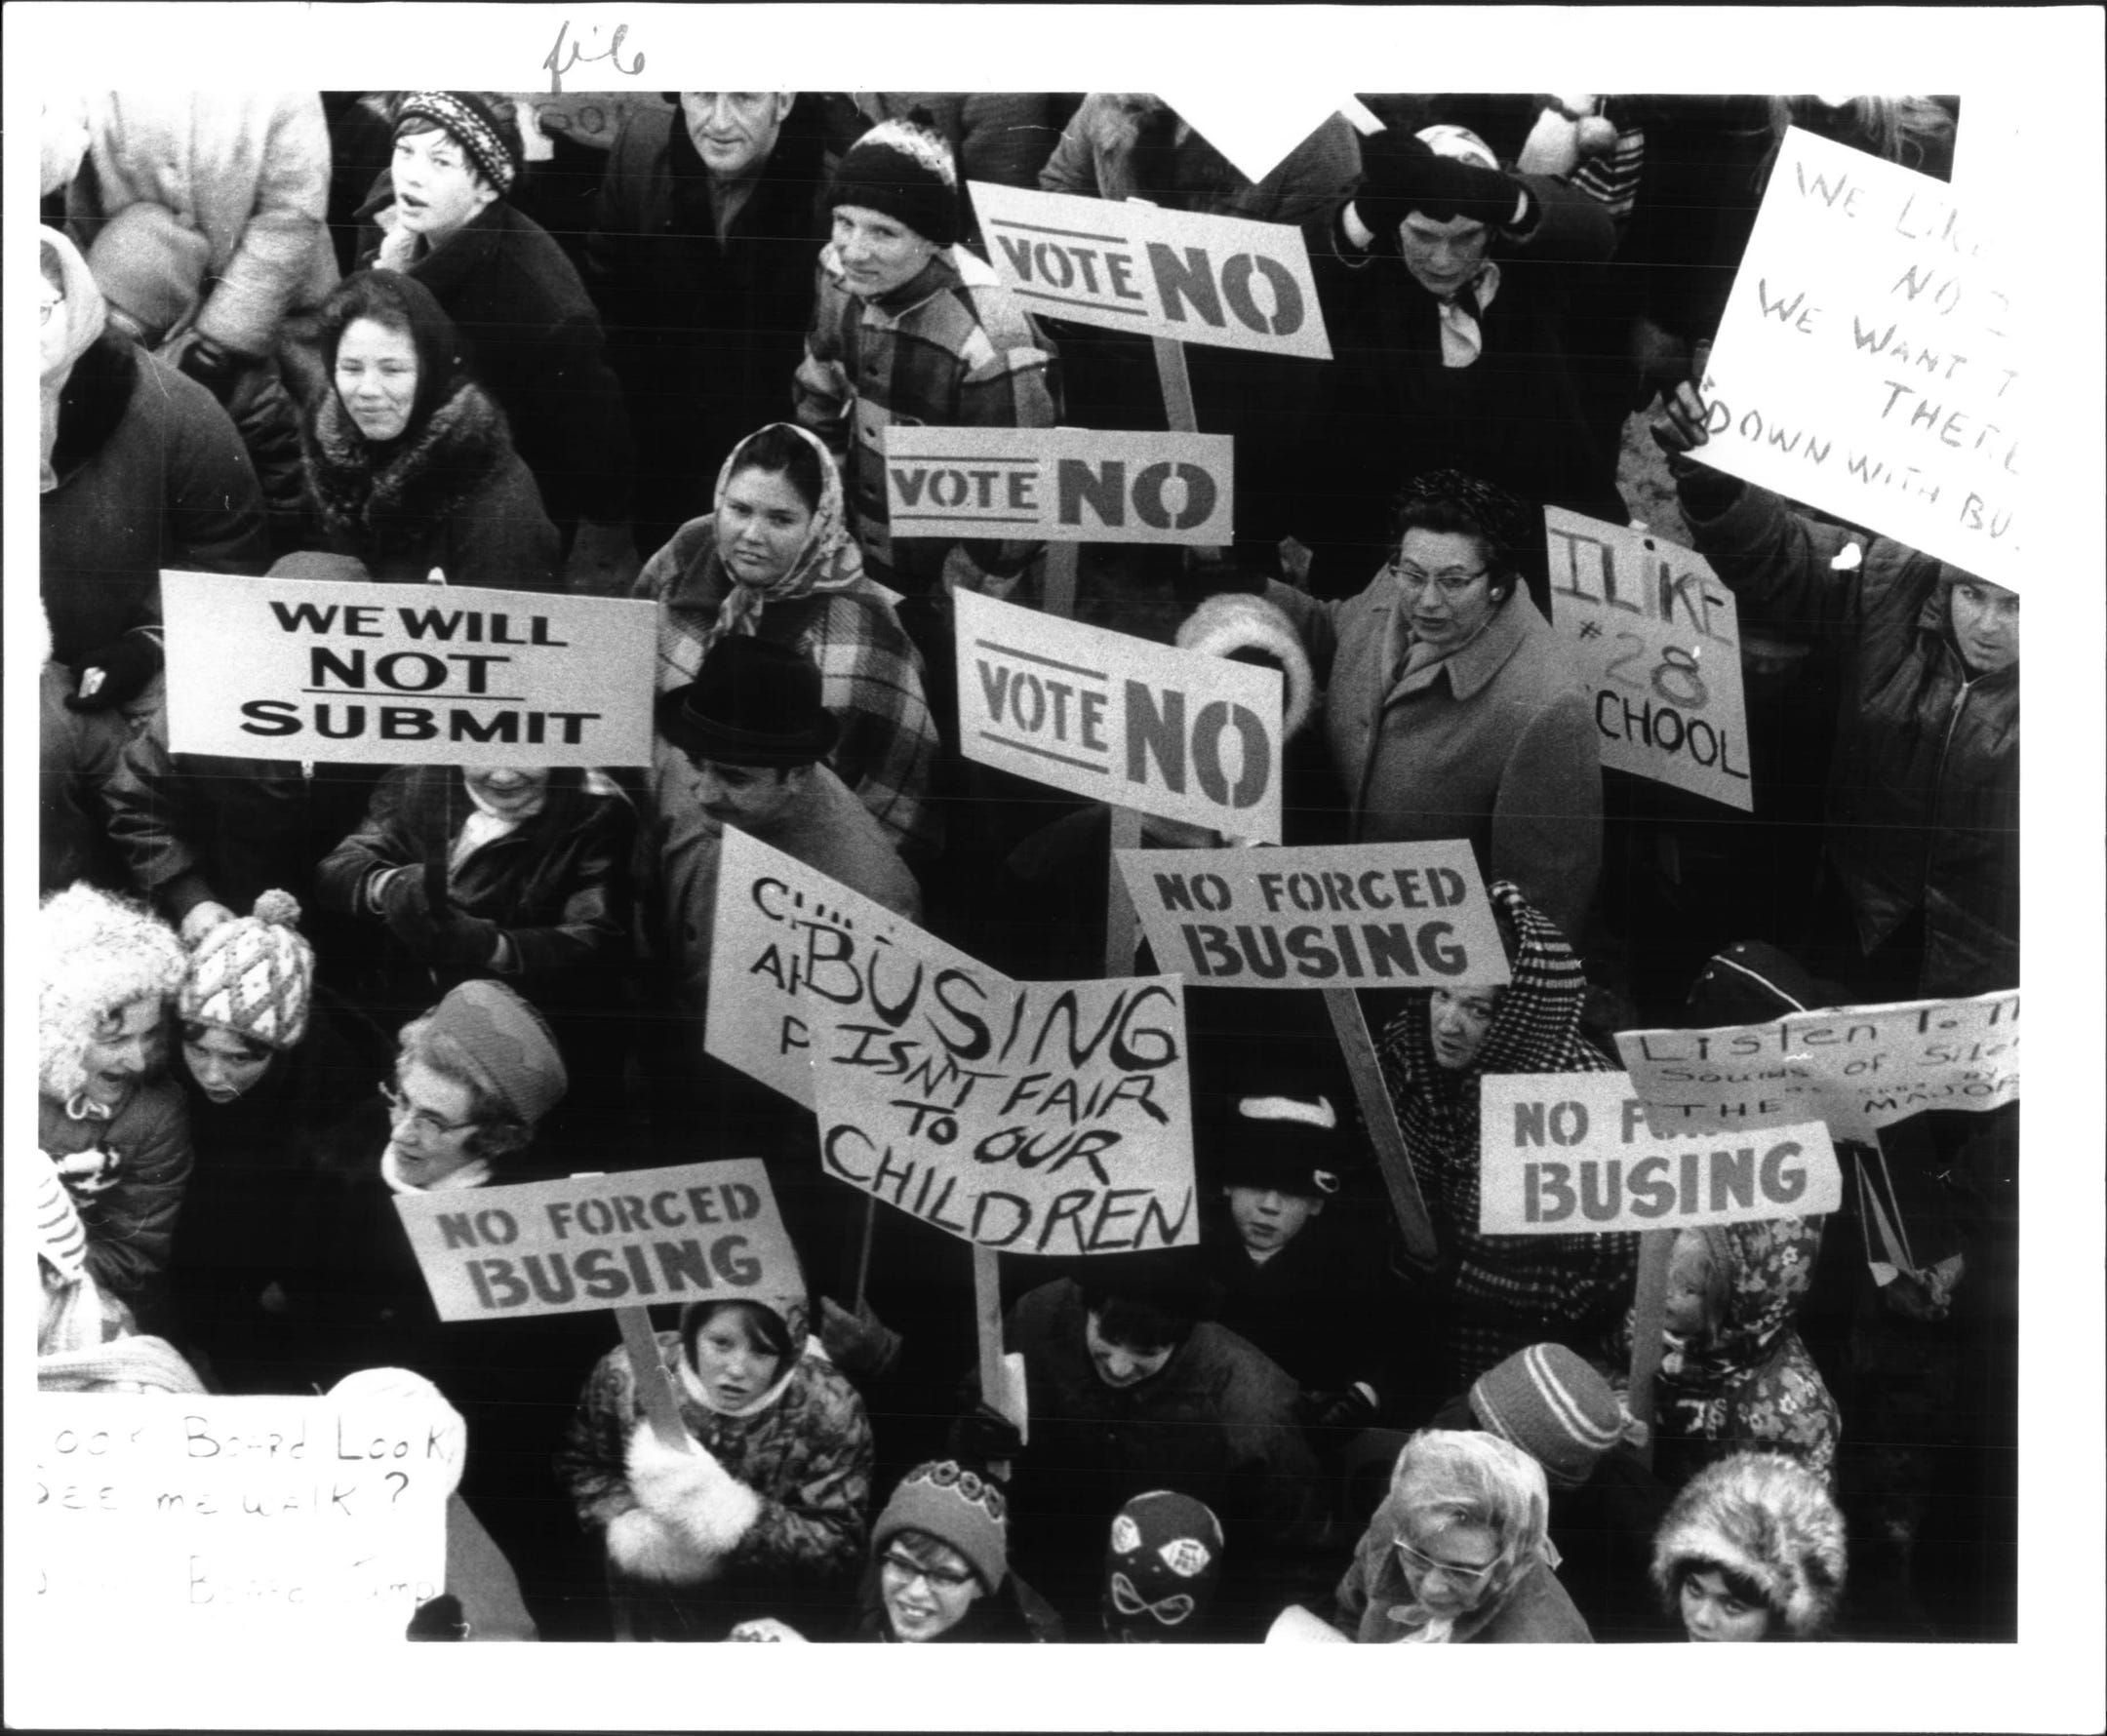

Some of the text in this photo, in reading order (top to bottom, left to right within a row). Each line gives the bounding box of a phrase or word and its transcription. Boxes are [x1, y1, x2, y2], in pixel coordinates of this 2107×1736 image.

[1796, 161, 1865, 217] WE
[997, 235, 1305, 335] VOTE NO
[1890, 264, 1961, 315] NO
[1759, 278, 1823, 334] WE
[1853, 315, 1968, 379] WANT
[890, 458, 1216, 530] VOTE NO
[1849, 450, 1940, 504] WITH
[1960, 492, 2020, 552] BU
[268, 601, 569, 647] WE WILL
[310, 647, 510, 693] NOT
[240, 699, 601, 744] SUBMIT
[976, 658, 1271, 809] VOTE NO
[1586, 685, 1749, 779] CHOOL
[1153, 867, 1467, 912] NO FORCED
[1180, 921, 1468, 979] BUSING
[795, 919, 1178, 1072] BUSING
[999, 1073, 1170, 1124] FAIR
[1514, 1100, 1590, 1148] NO
[1663, 1099, 1781, 1118] THE
[889, 1100, 1123, 1186] TO OUR
[436, 1183, 761, 1250] NO FORCED
[825, 1124, 1193, 1251] CHILDREN
[1524, 1141, 1808, 1223] BUSING
[465, 1235, 763, 1309] BUSING
